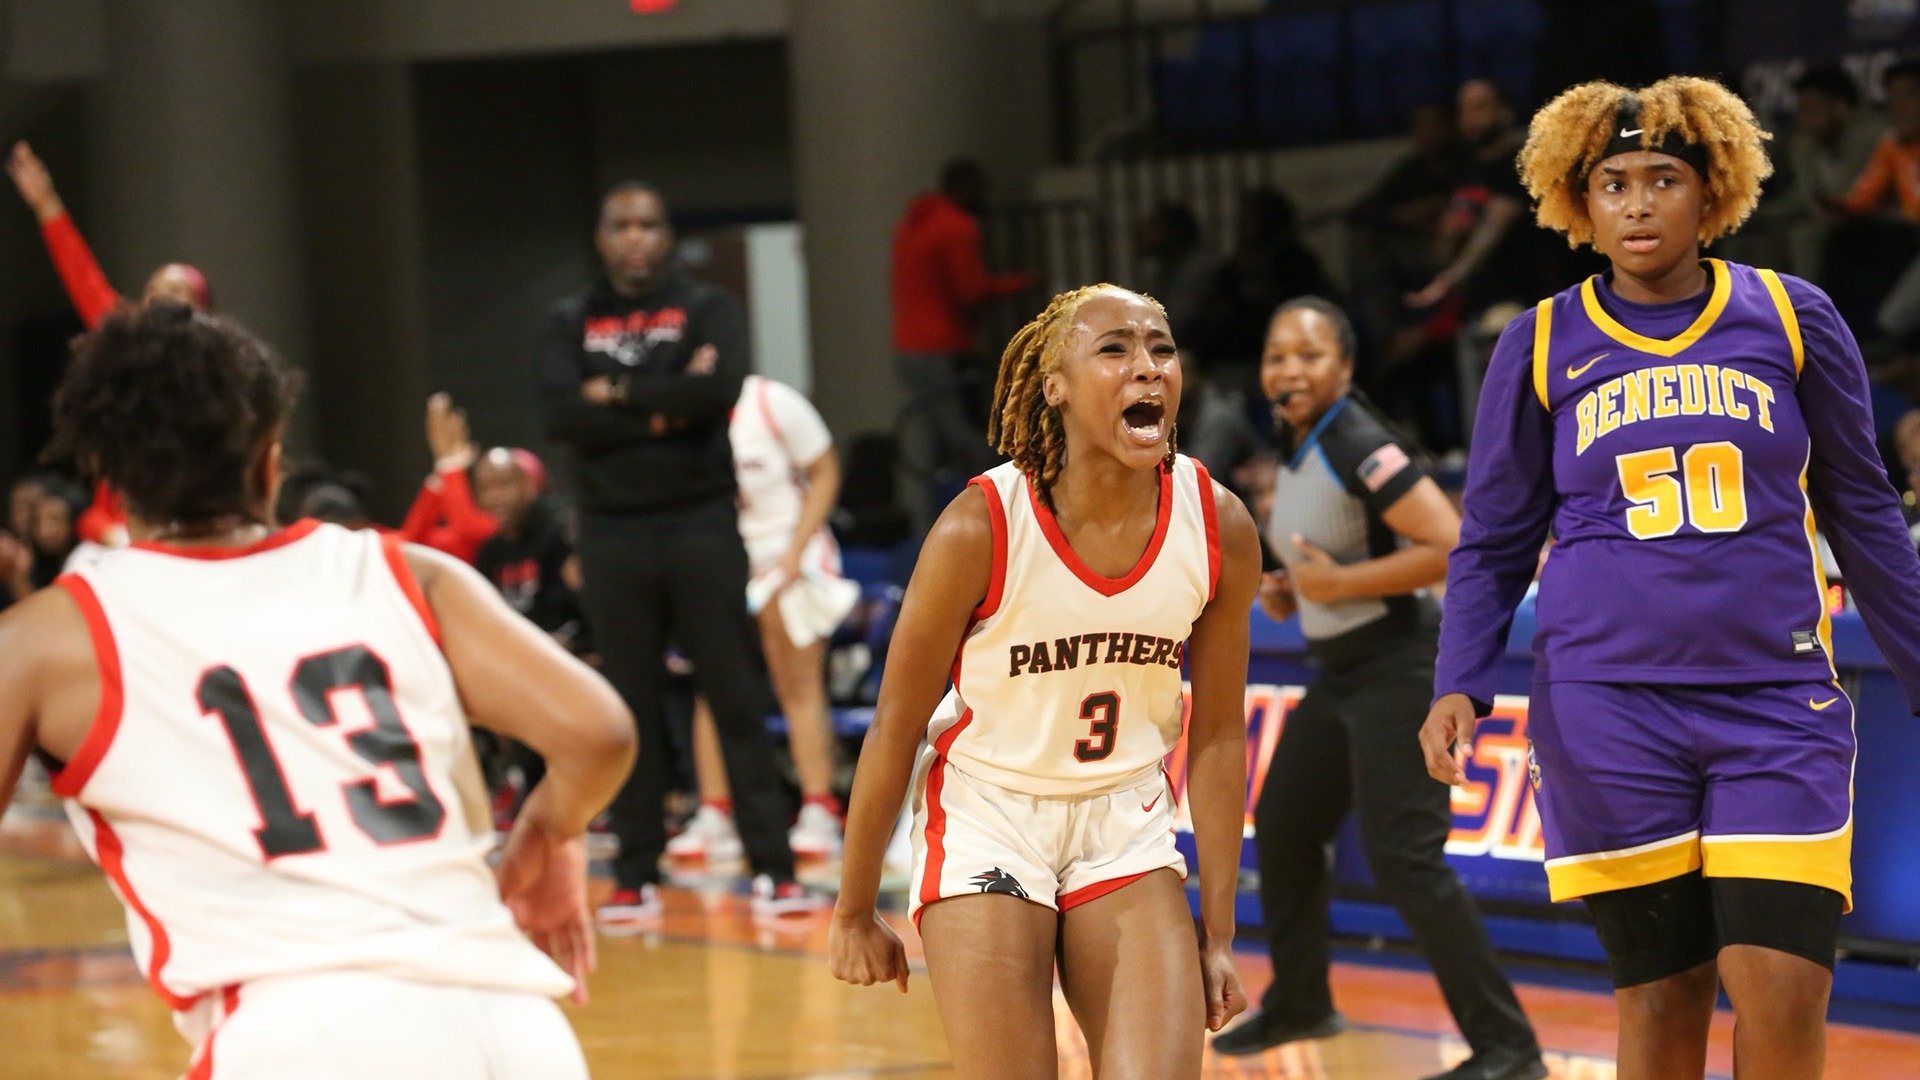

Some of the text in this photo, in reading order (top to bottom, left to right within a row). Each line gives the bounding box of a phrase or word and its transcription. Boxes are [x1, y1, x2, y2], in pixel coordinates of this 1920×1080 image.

[1576, 364, 1775, 456] BENEDICT
[1615, 441, 1748, 540] 50
[1009, 632, 1183, 678] PANTHERS
[195, 643, 446, 864] 13
[1073, 690, 1121, 763] 3
